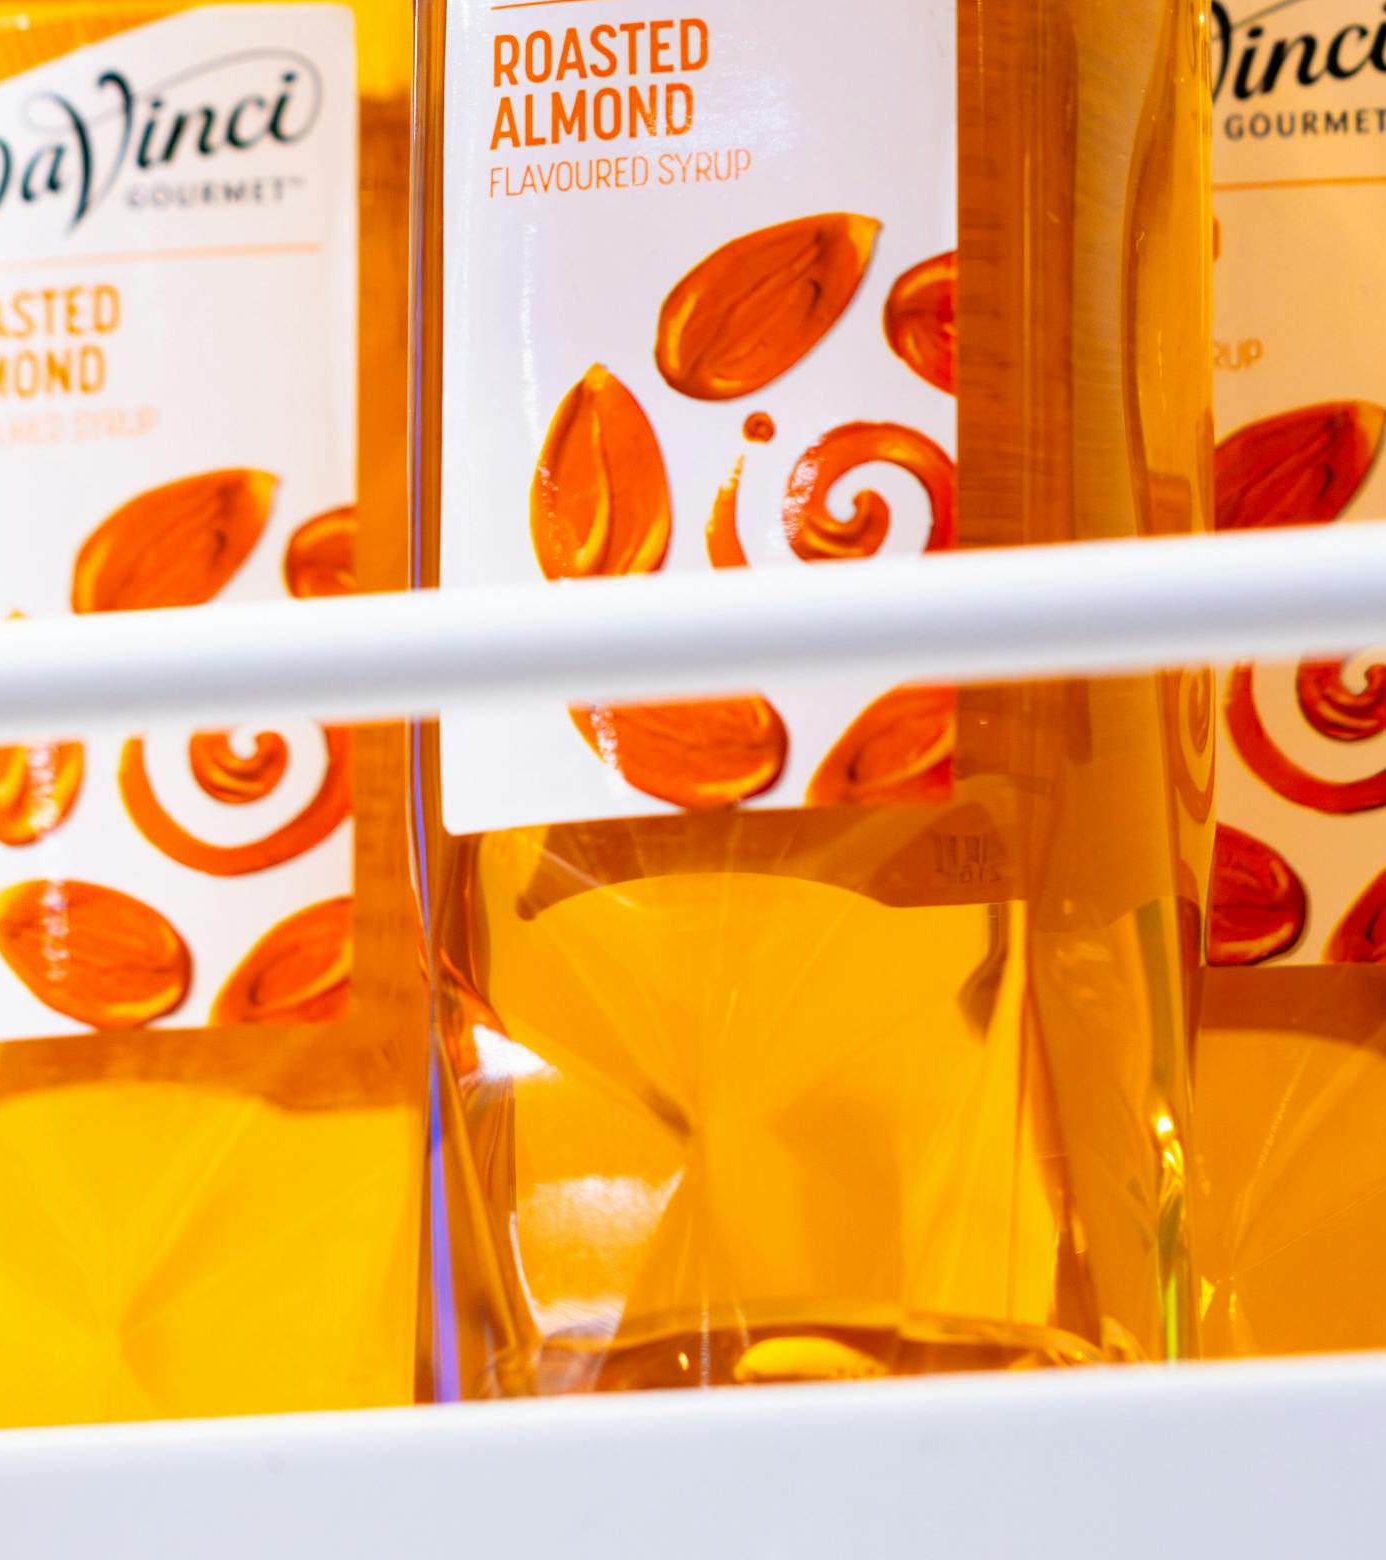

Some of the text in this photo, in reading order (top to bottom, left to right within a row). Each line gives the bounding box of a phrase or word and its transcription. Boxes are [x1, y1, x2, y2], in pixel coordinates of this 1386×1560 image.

[492, 17, 709, 87] ROASTED
[489, 82, 694, 150] ALMOND
[489, 148, 751, 197] FLAVOURED SYRUP
